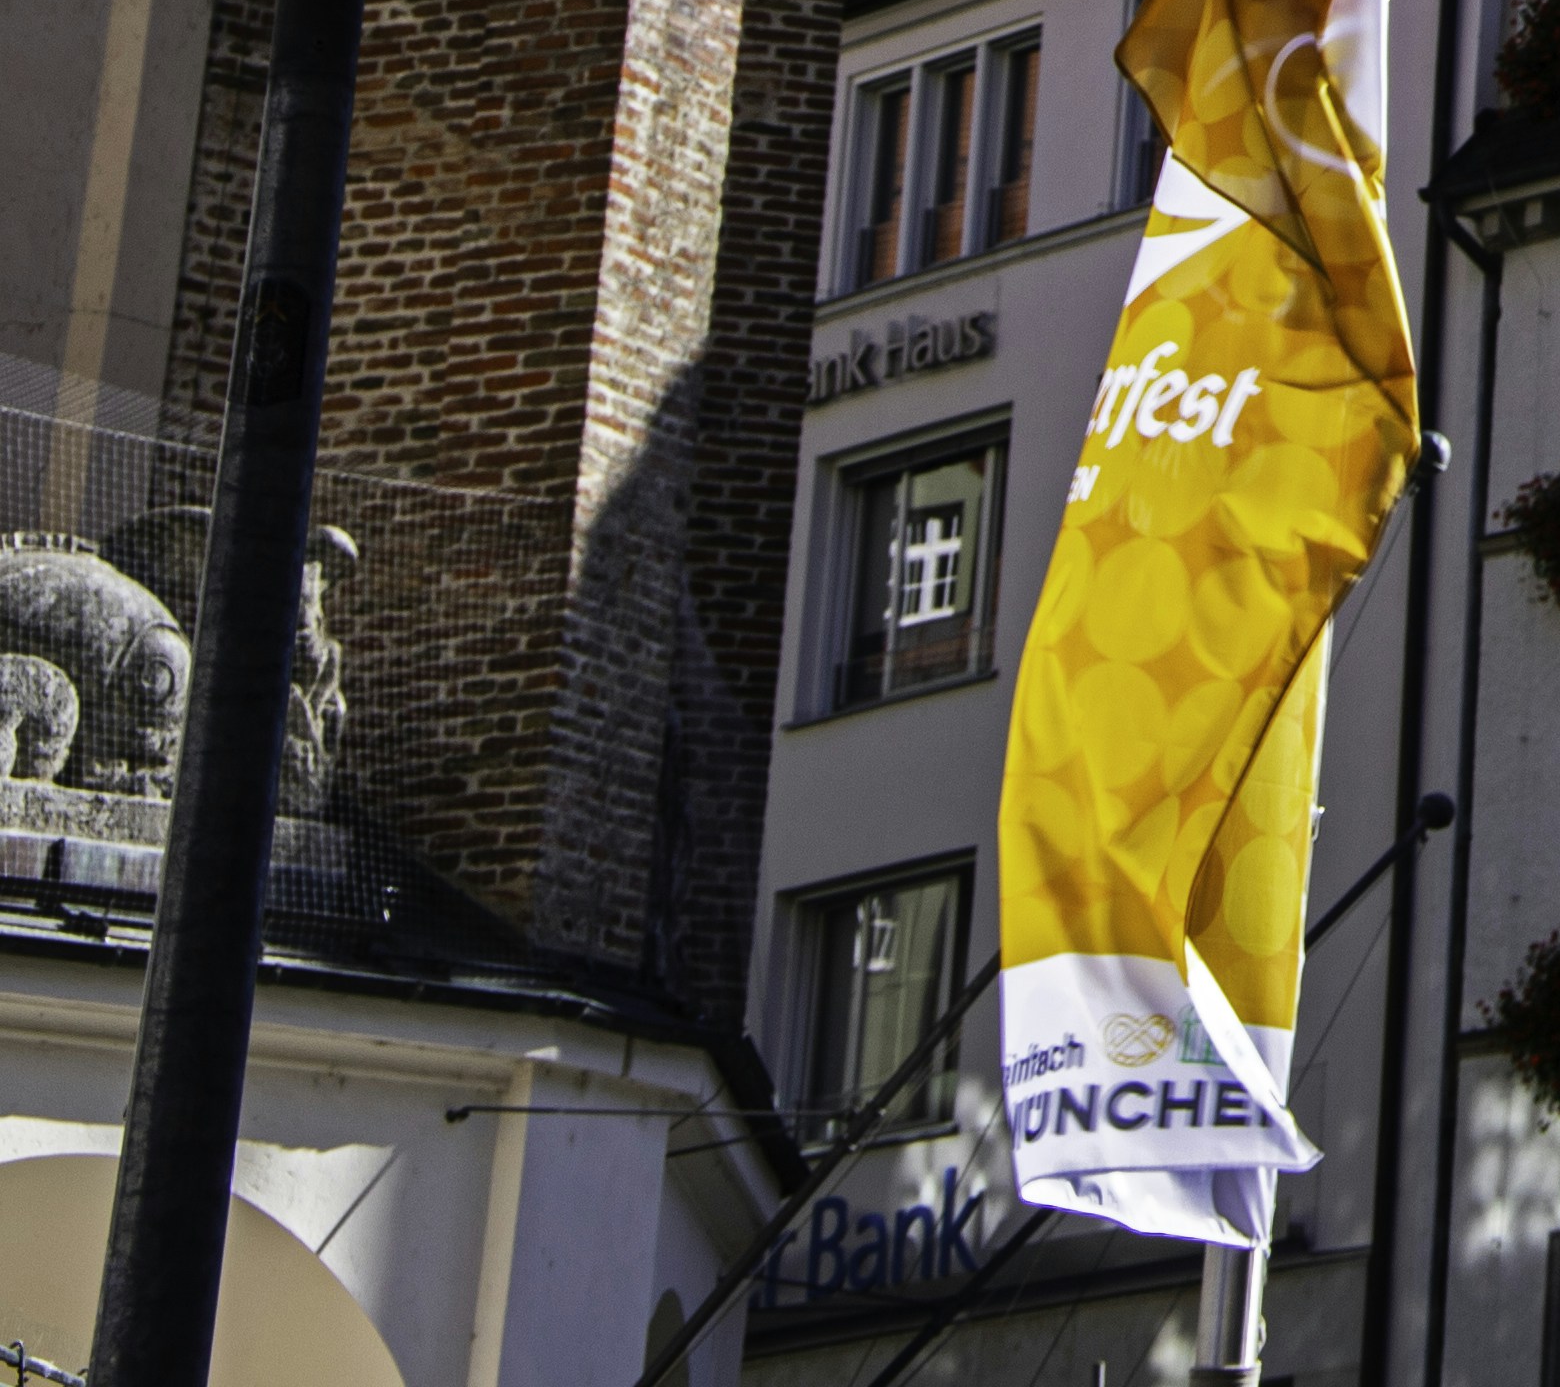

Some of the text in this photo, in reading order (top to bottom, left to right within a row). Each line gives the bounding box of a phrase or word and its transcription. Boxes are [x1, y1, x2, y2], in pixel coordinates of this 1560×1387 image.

[885, 312, 997, 381] Haus
[1010, 1079, 1273, 1150] ÜNCHE
[807, 1166, 985, 1301] Bank
